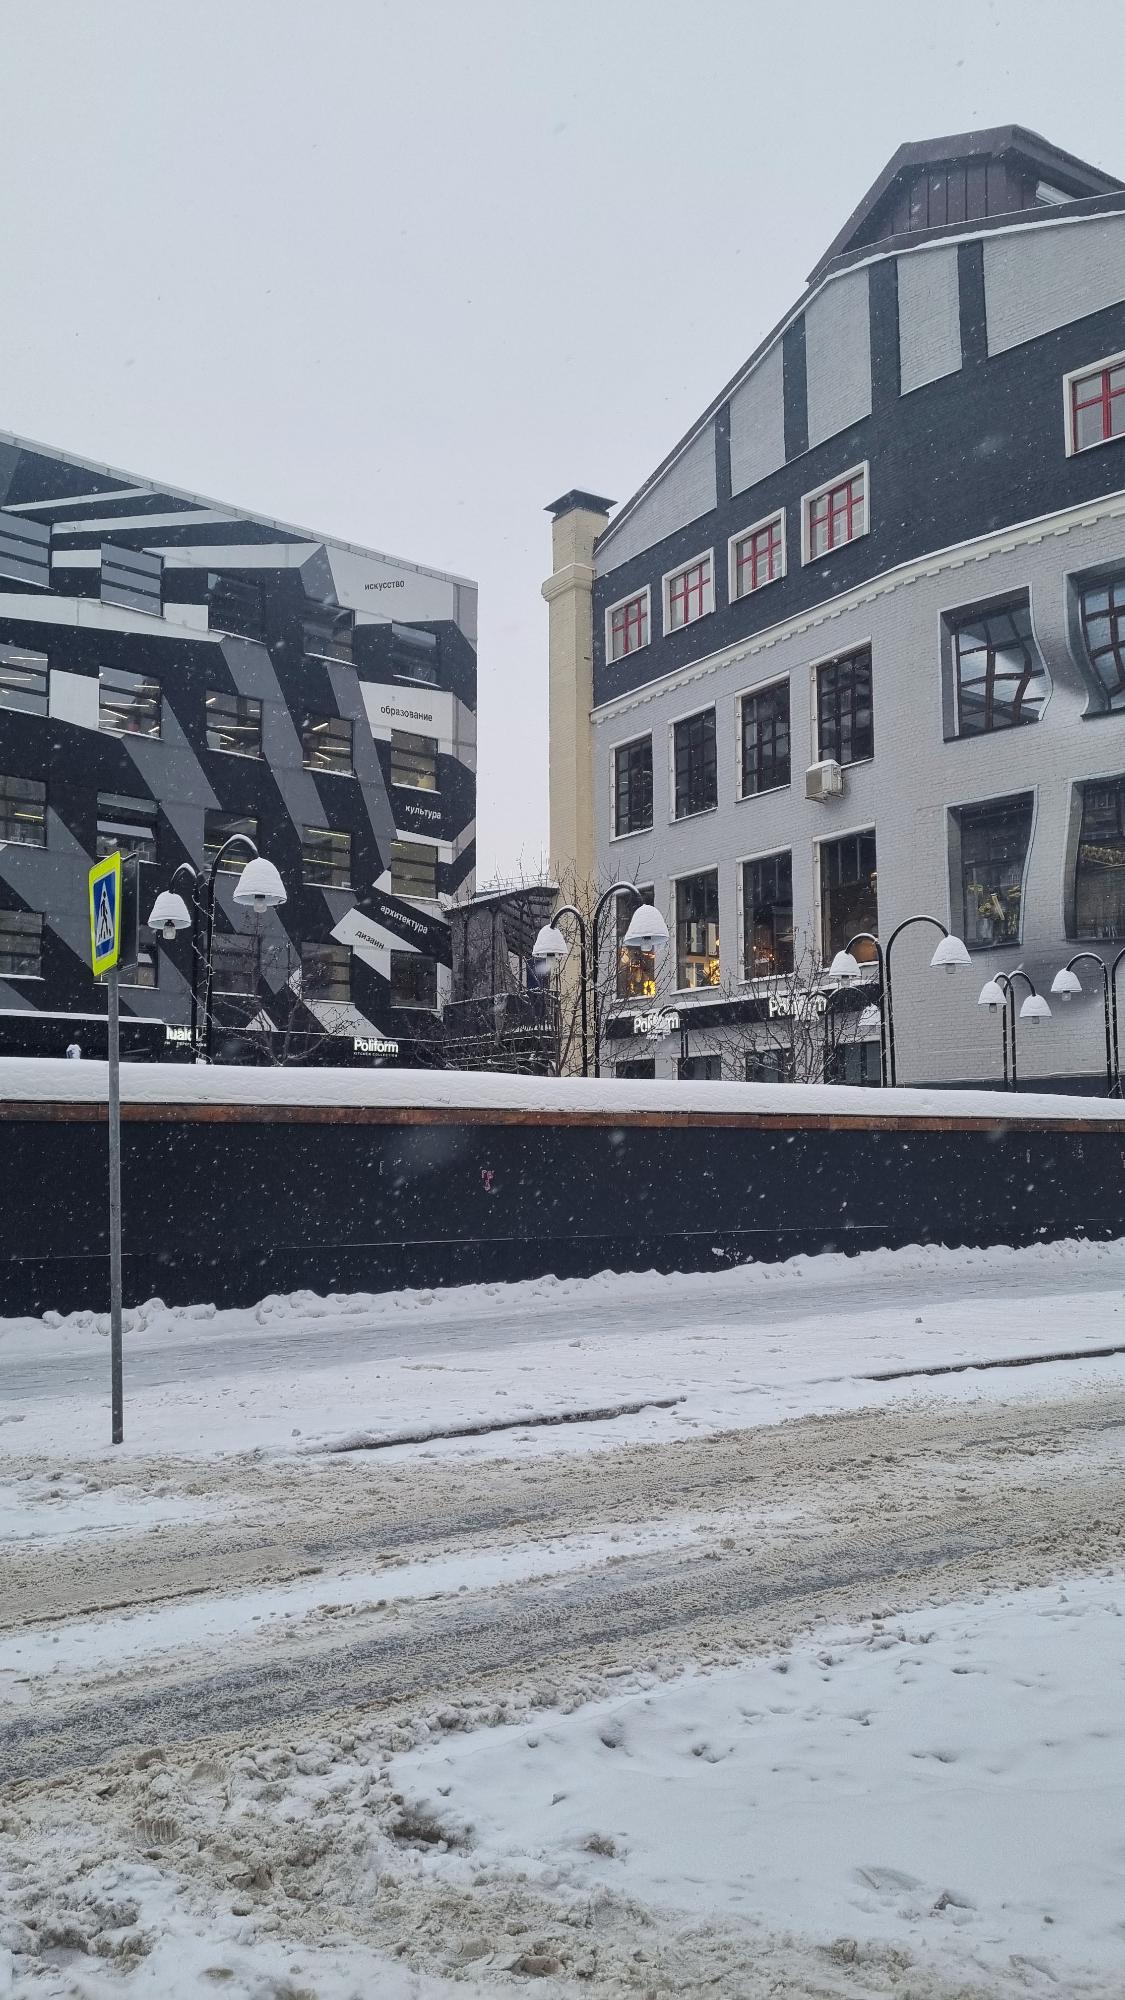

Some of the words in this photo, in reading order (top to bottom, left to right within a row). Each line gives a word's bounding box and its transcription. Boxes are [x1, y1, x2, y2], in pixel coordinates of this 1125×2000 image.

[364, 580, 405, 591] искусство
[380, 705, 433, 722] образование
[405, 804, 442, 820] культура
[380, 905, 428, 934] архитектура
[354, 1038, 399, 1053] Poliform
